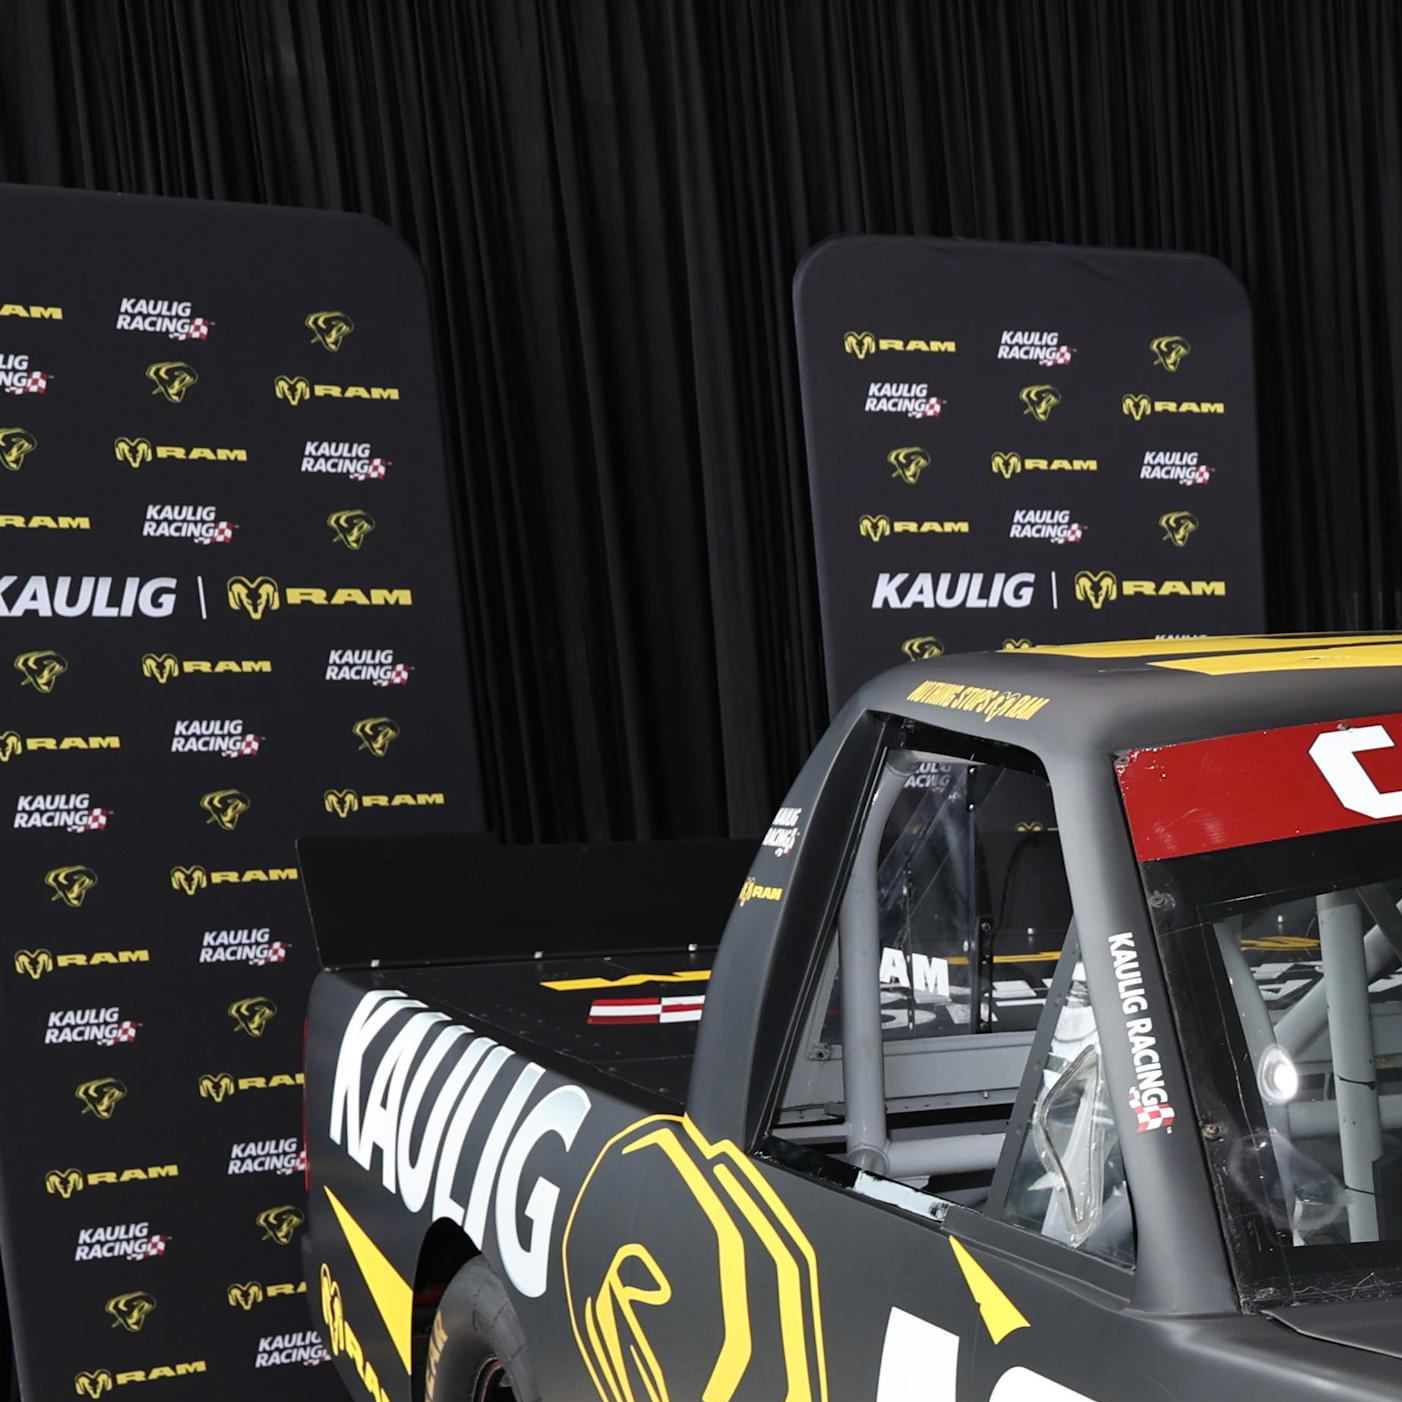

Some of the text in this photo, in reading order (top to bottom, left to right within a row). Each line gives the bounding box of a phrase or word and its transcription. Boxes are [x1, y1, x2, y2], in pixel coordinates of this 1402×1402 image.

[0, 304, 62, 318] AM
[120, 298, 191, 316] KAULIG
[117, 315, 189, 332] RACING
[878, 339, 957, 352] RAM
[1001, 331, 1058, 345] KAULIG
[998, 346, 1055, 359] RACING
[314, 385, 400, 399] RAM
[869, 383, 927, 397] KAULIG
[865, 398, 927, 411] RACING
[1154, 402, 1225, 413] RAM
[156, 446, 247, 460] RAM
[305, 442, 370, 457] KAULIG
[301, 458, 369, 472] RACING
[1024, 459, 1098, 470] RAM
[1144, 452, 1198, 465] KAULIG
[1140, 466, 1195, 479] RACING
[147, 505, 215, 521] KAULIG
[1014, 510, 1069, 523] KAULIG
[0, 515, 90, 528] RAM
[143, 521, 215, 536] RACING
[893, 522, 969, 532] RAM
[1010, 525, 1069, 537] RACING
[286, 588, 412, 604] RAM
[872, 573, 1226, 608] KAULIG RAM
[329, 650, 392, 664] KAULIG
[183, 661, 271, 672] RAM
[326, 666, 392, 680] RACING
[175, 720, 242, 735] KAULIG
[26, 736, 120, 750] RAM
[172, 736, 242, 751] RACING
[18, 794, 89, 811] KAULIG
[362, 794, 444, 806] RAM
[14, 811, 88, 827] RACING
[211, 868, 298, 883] RAM
[203, 928, 269, 944] KAULIG
[56, 950, 149, 966] RAM
[200, 944, 268, 962] RACING
[49, 1008, 118, 1026] KAULIG
[1106, 930, 1168, 1107] KAULIG RACING
[45, 1024, 117, 1043] RACING
[231, 1138, 296, 1158] KAULIG
[330, 990, 592, 1298] KAULIG
[228, 1154, 297, 1174] RACING
[87, 1165, 179, 1185] RAM
[79, 1223, 148, 1244] KAULIG
[75, 1239, 147, 1260] RACING
[256, 1345, 325, 1367] RACING
[116, 1361, 206, 1384] RAM
